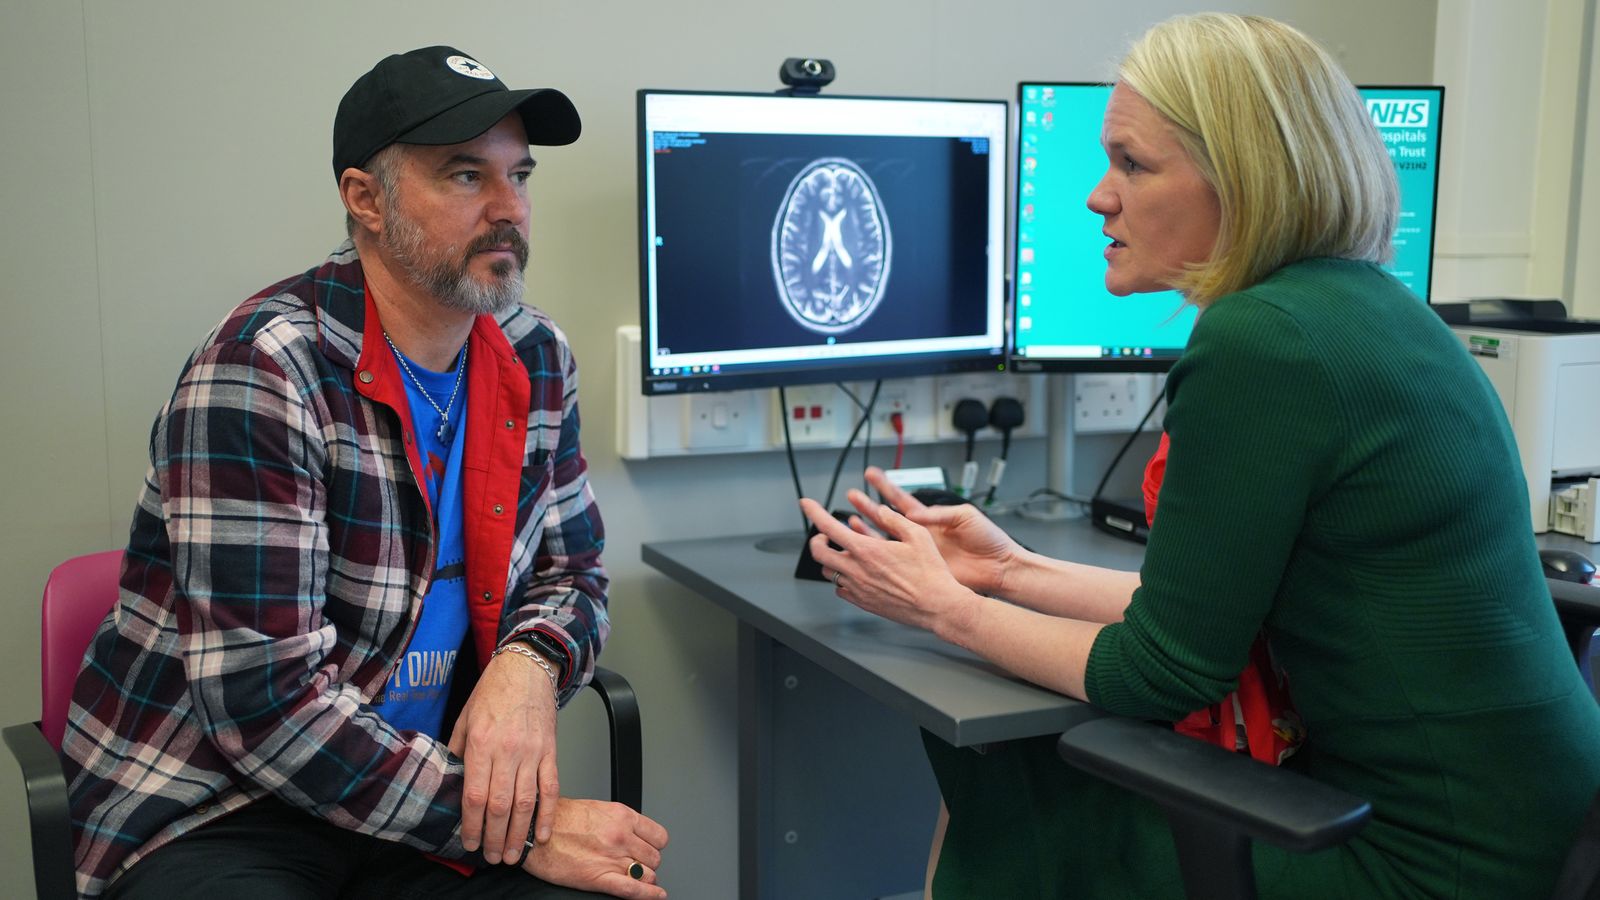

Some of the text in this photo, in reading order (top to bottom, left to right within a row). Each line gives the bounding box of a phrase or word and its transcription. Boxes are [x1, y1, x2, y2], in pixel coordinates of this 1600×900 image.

[1370, 103, 1425, 124] NHS
[1381, 129, 1427, 145] ospitals
[1398, 145, 1426, 158] Trust
[389, 690, 409, 703] Real
